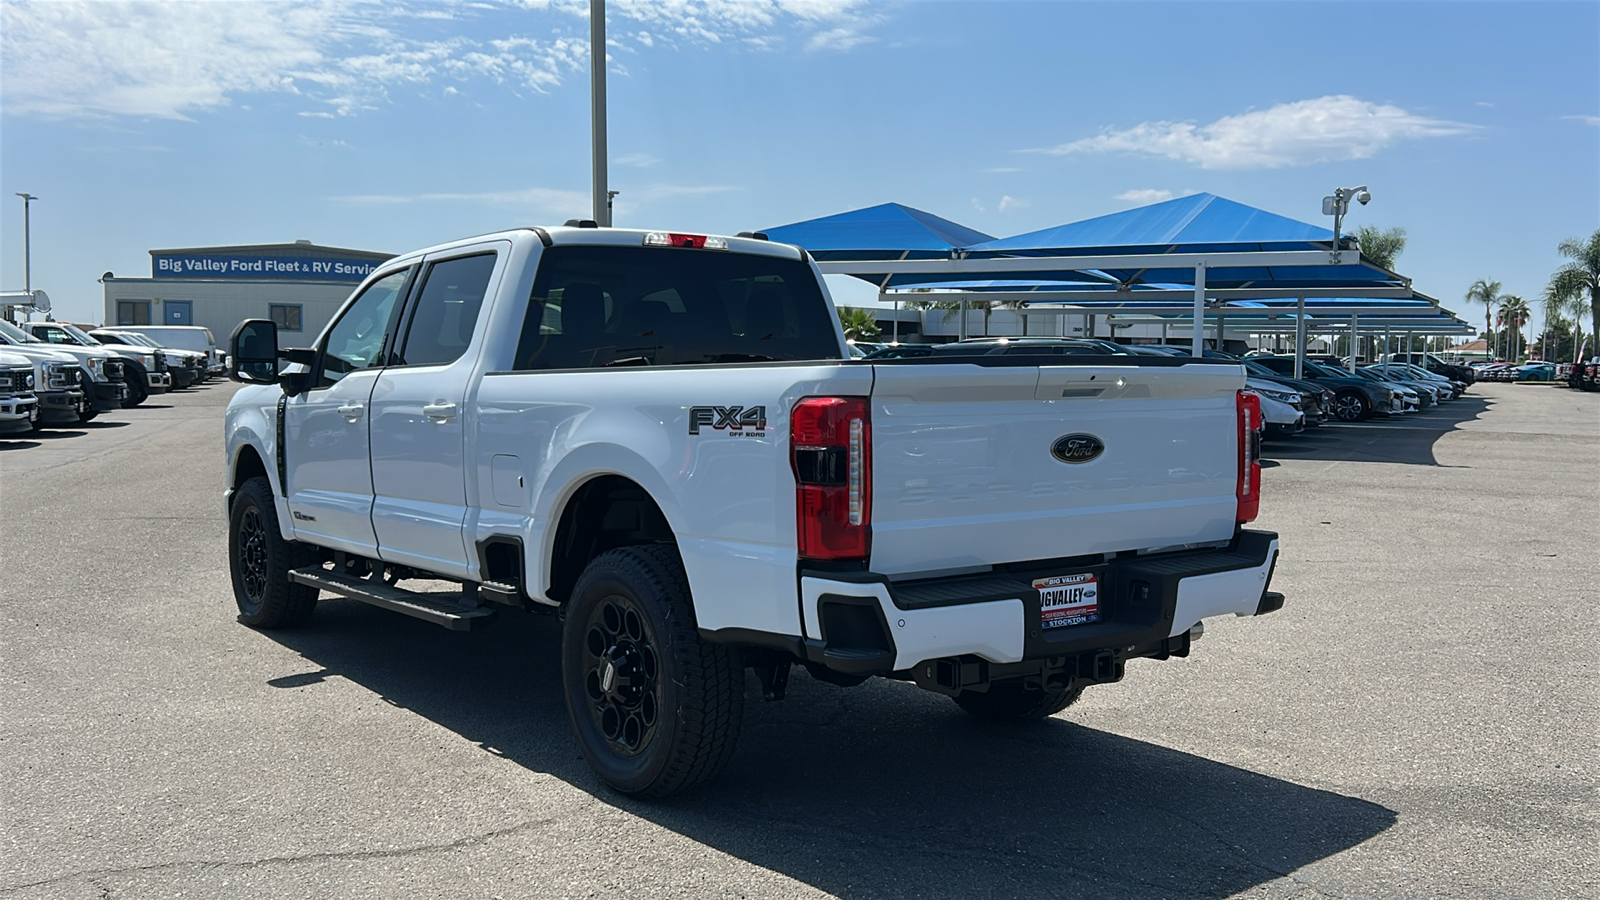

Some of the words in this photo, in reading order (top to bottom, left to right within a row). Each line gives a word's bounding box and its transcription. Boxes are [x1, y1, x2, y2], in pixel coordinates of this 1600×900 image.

[159, 259, 182, 273] Big
[184, 259, 228, 273] Valley
[230, 260, 262, 272] Ford
[265, 260, 300, 272] Fleet
[302, 263, 310, 272] &
[312, 261, 332, 273] RV
[334, 262, 377, 275] Servic
[688, 405, 766, 435] FX4
[1065, 439, 1094, 457] Ford
[1040, 588, 1084, 608] IGVALLEY
[1049, 616, 1086, 626] STOCKTON
